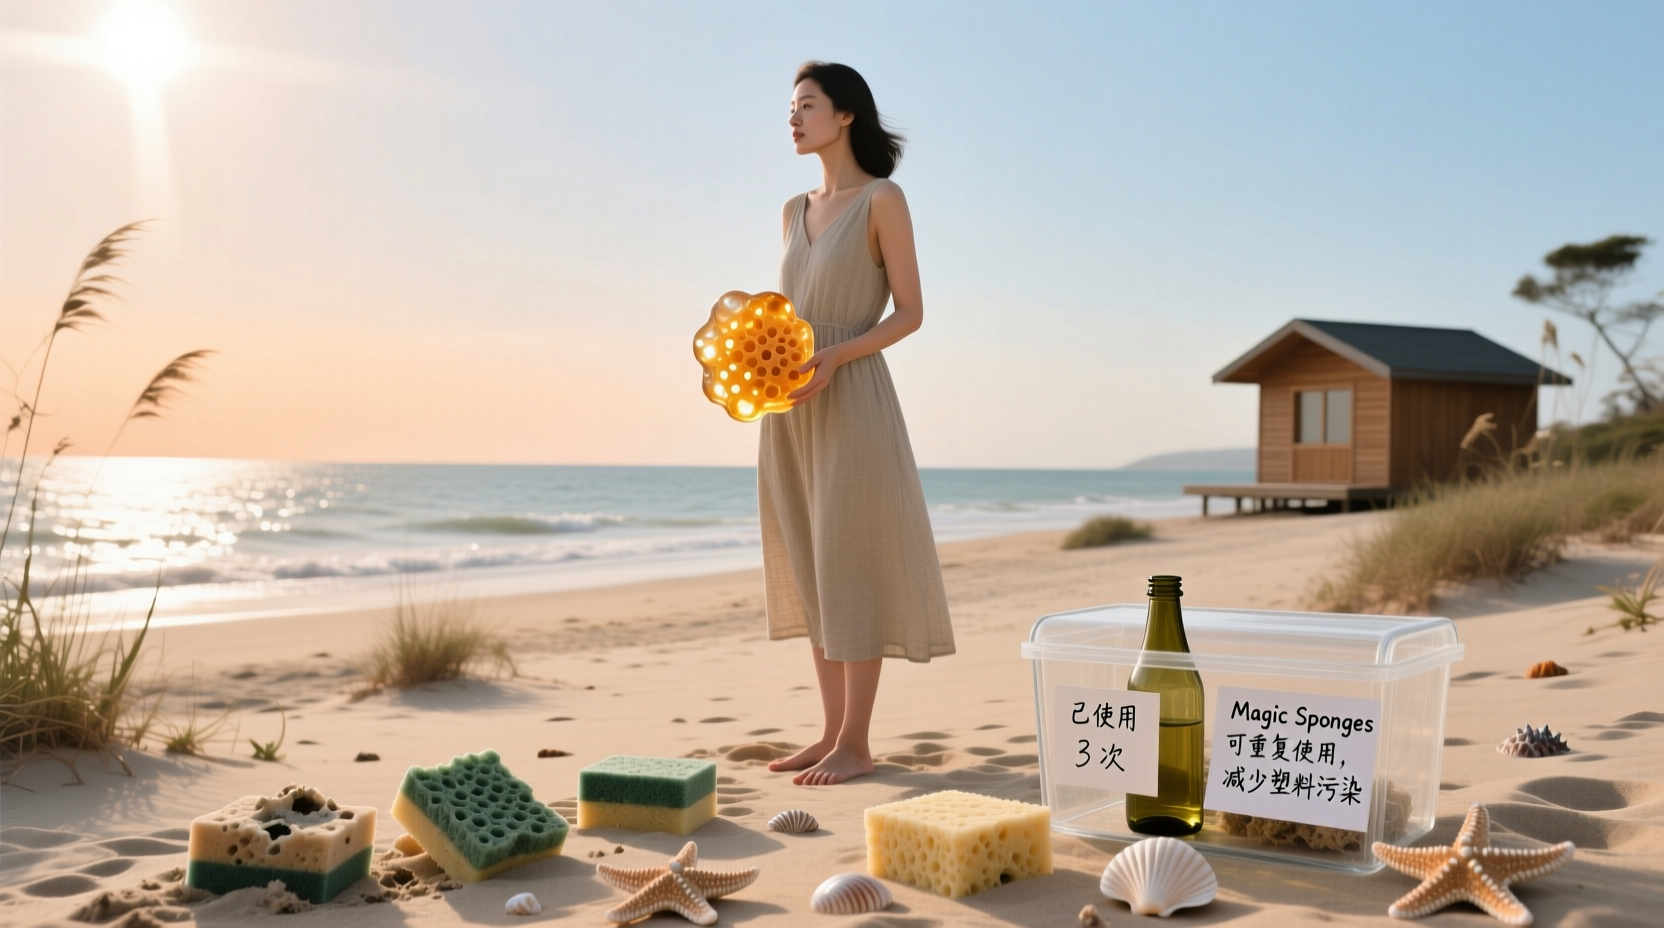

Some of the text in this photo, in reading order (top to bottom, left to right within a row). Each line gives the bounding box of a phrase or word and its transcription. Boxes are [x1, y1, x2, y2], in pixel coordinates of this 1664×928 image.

[1230, 700, 1374, 738] Magic Sponges
[1222, 765, 1363, 806] 减少塑料污染
